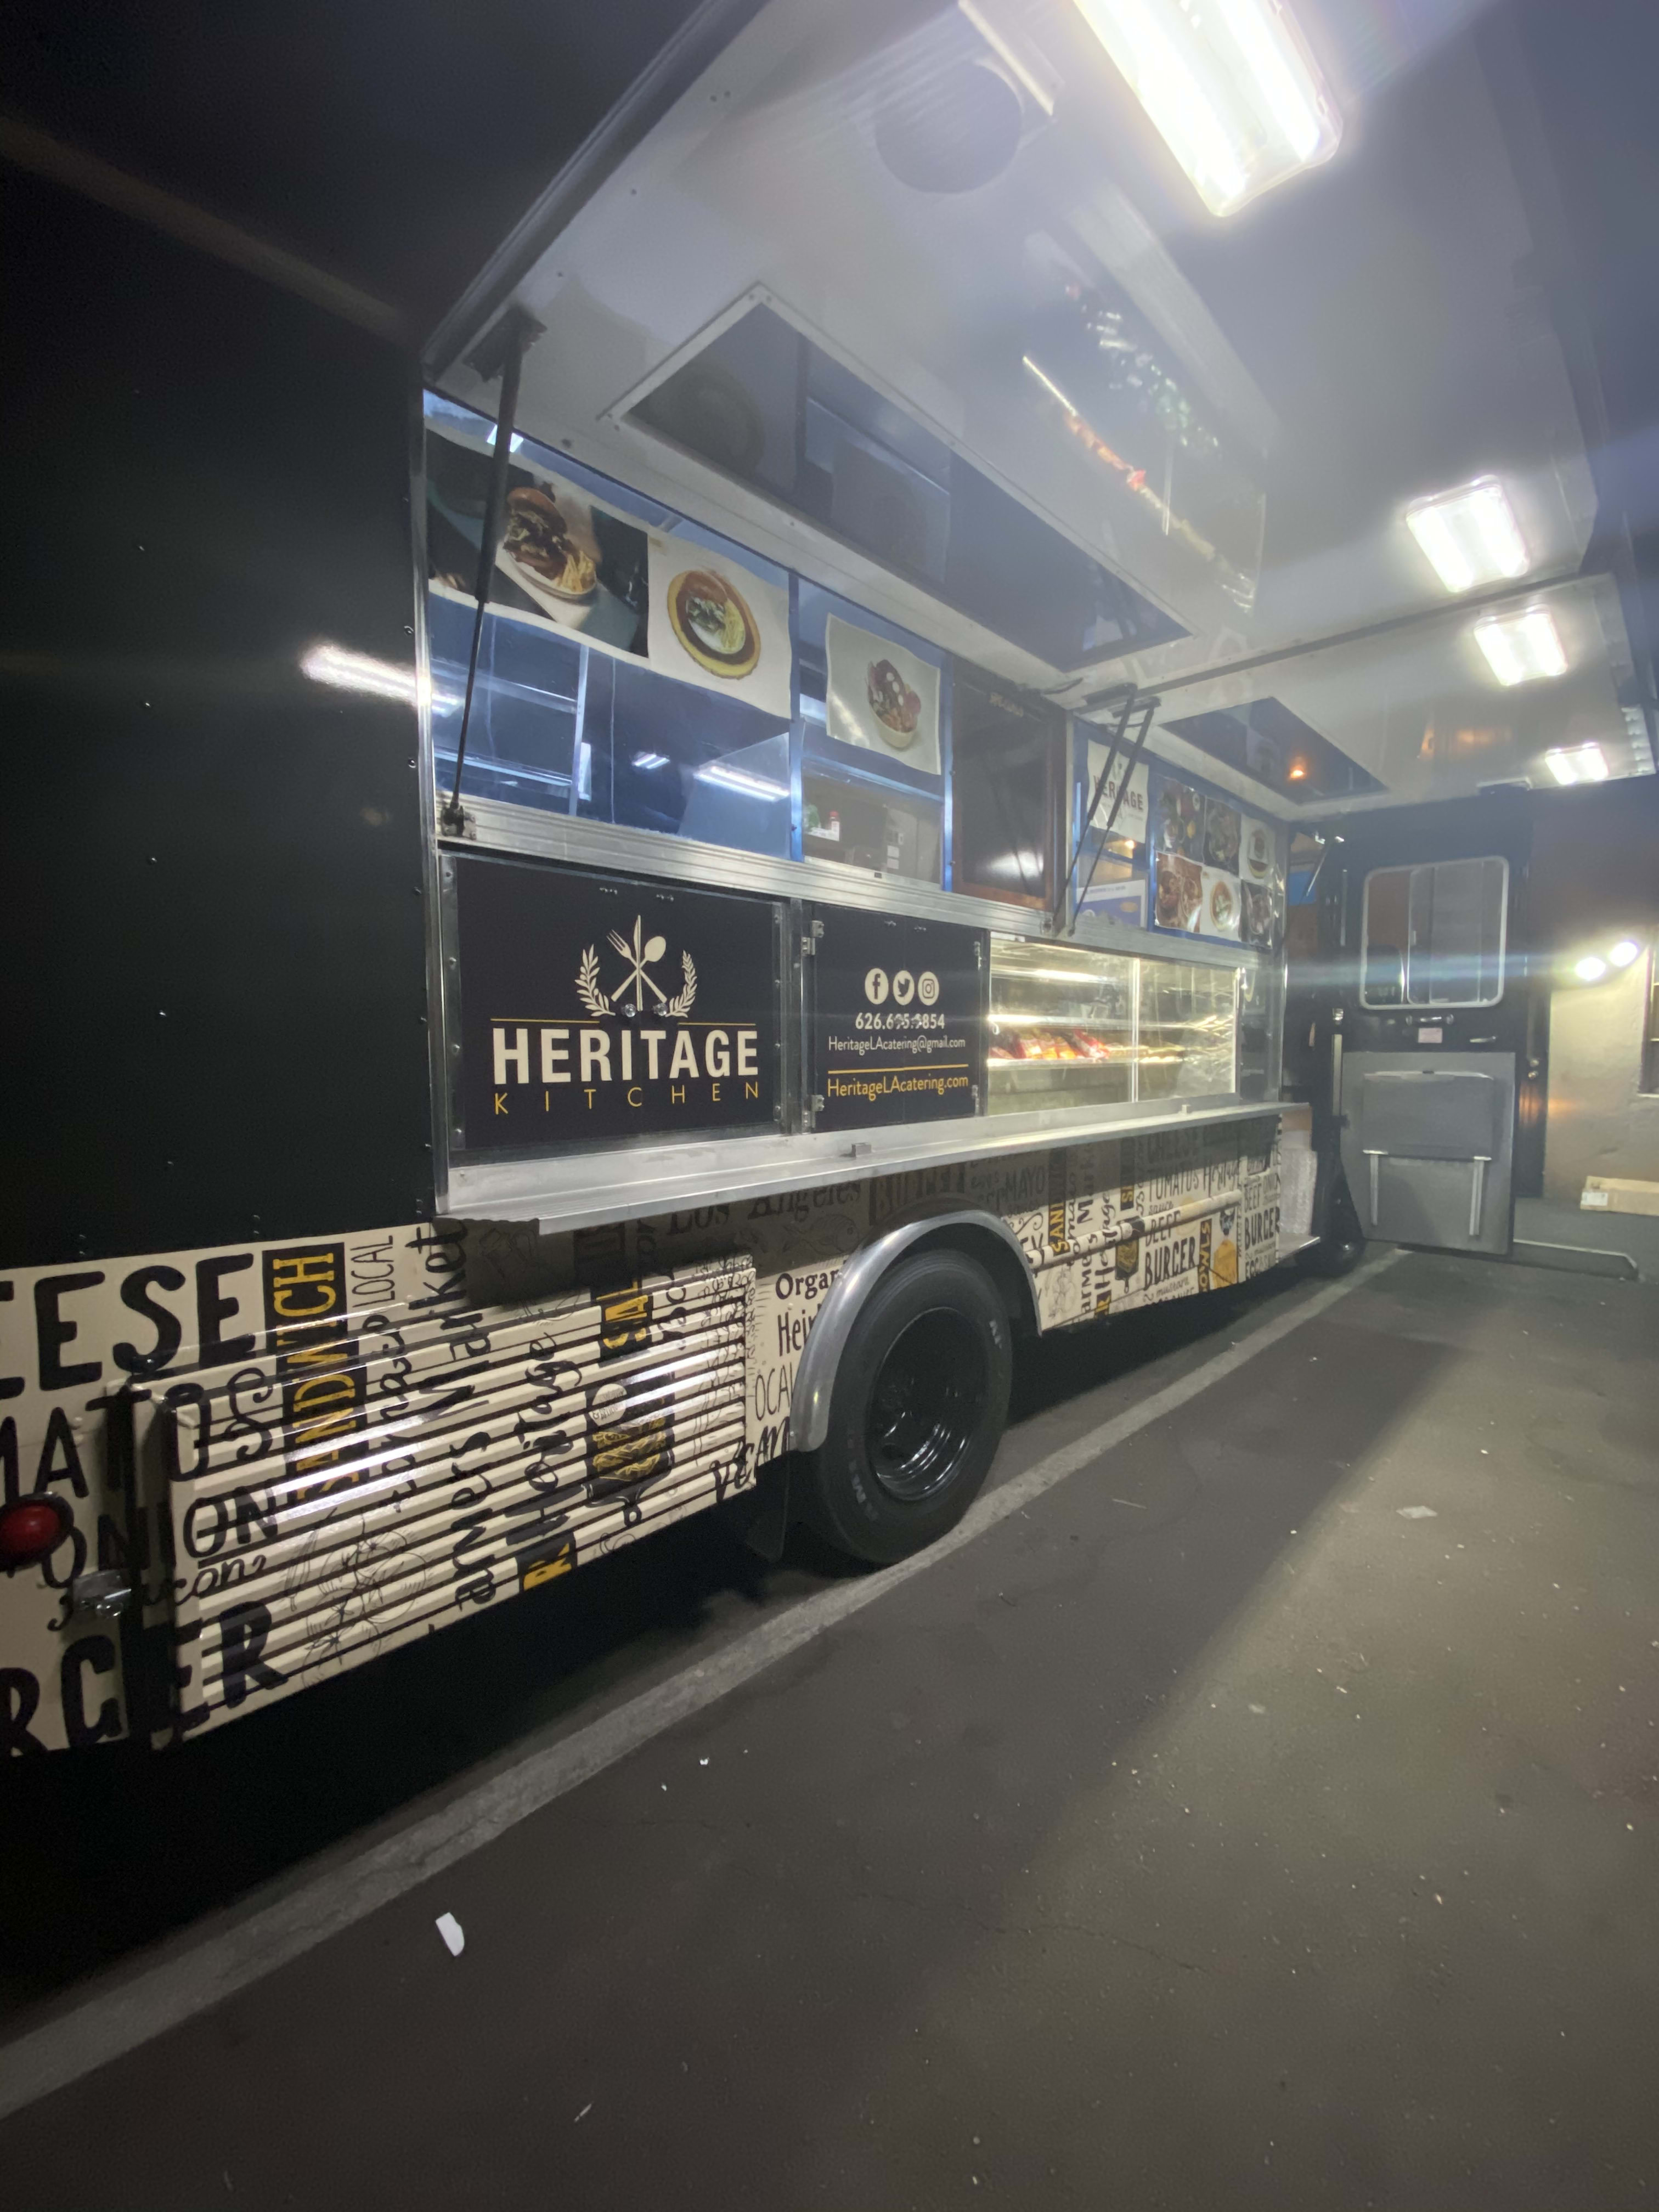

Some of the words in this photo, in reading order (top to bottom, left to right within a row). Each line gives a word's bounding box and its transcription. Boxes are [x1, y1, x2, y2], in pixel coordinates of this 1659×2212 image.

[493, 1028, 758, 1085] HERITAGE
[829, 1035, 966, 1056] HeritageLAcatering@gmail.com
[495, 1082, 759, 1115] KITCHEN
[828, 1076, 968, 1101] HeritageLAcatering.com
[351, 1235, 395, 1308] LOCAL
[1144, 1237, 1198, 1291] BURGER
[0, 1253, 256, 1400] ESE
